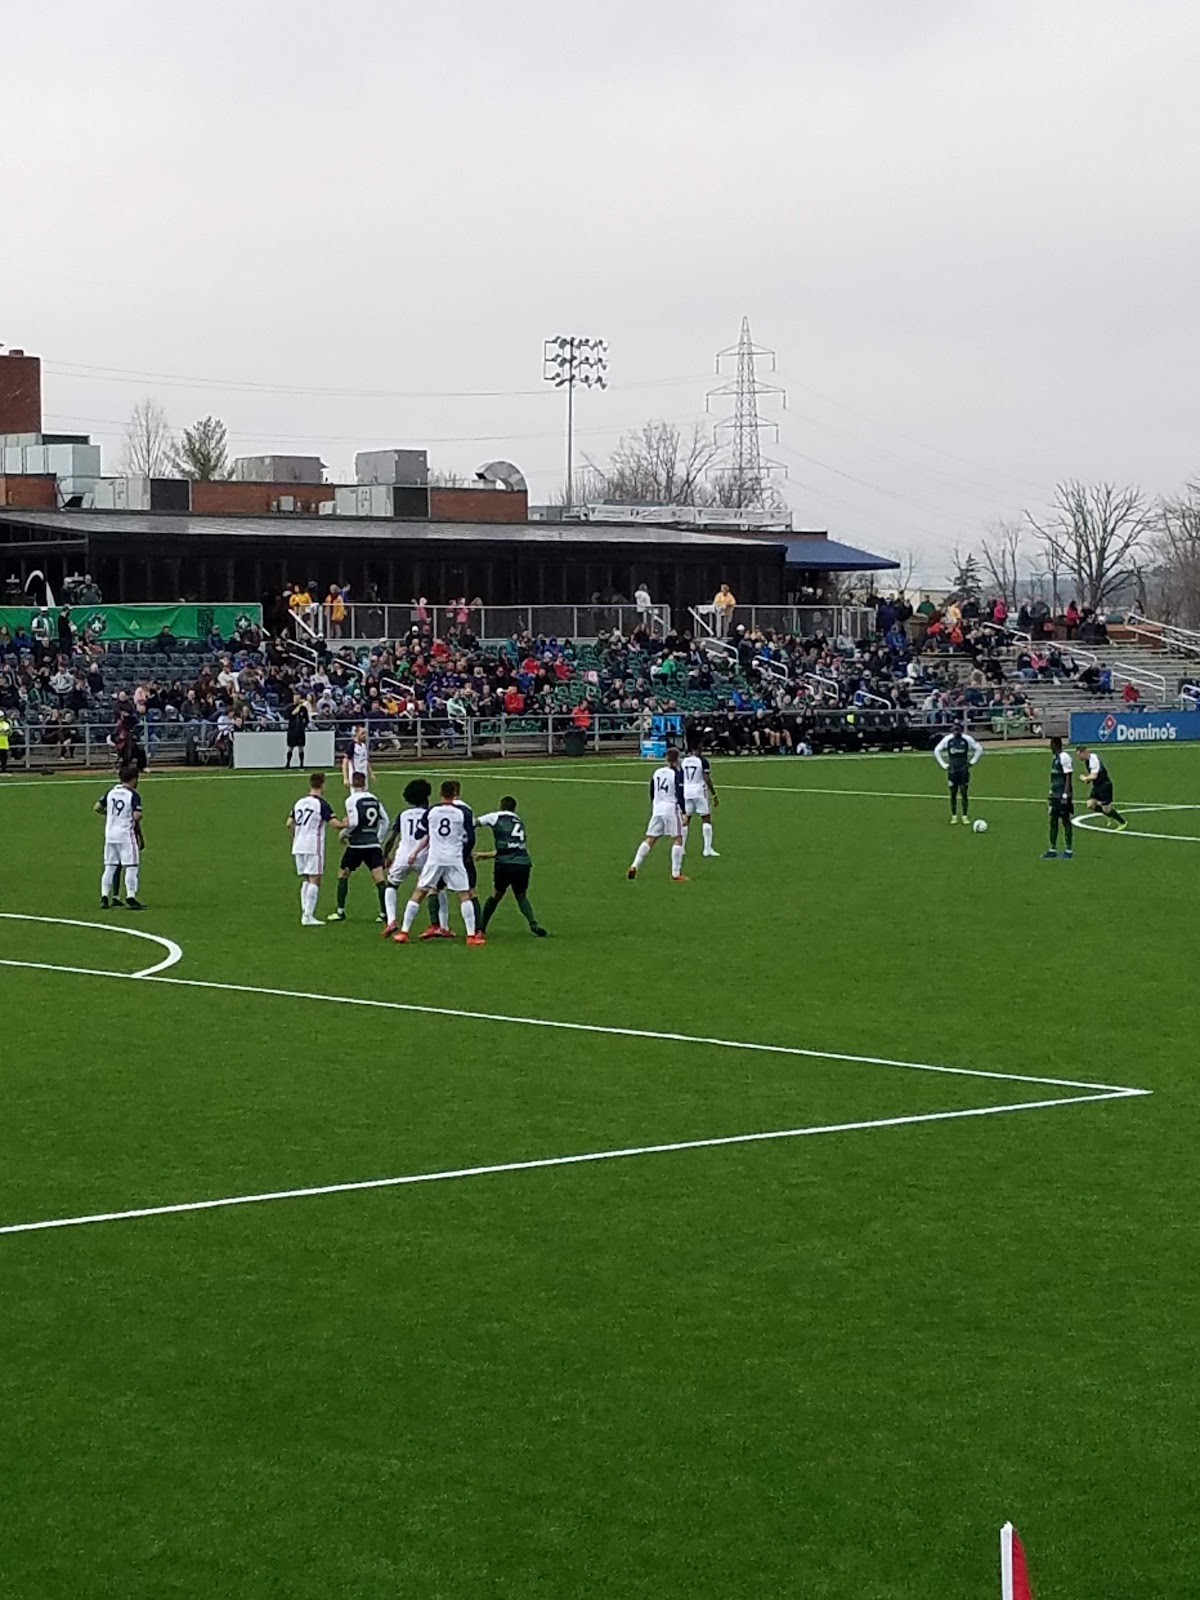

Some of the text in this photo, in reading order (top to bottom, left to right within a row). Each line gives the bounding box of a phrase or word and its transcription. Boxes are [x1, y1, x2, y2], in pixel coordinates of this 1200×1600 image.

[1116, 722, 1177, 741] Domino's
[684, 766, 697, 780] 17
[657, 776, 669, 794] 14
[112, 798, 125, 816] 19
[296, 808, 314, 826] 27
[366, 807, 378, 826] 9
[438, 817, 452, 836] 8
[511, 823, 524, 841] 4
